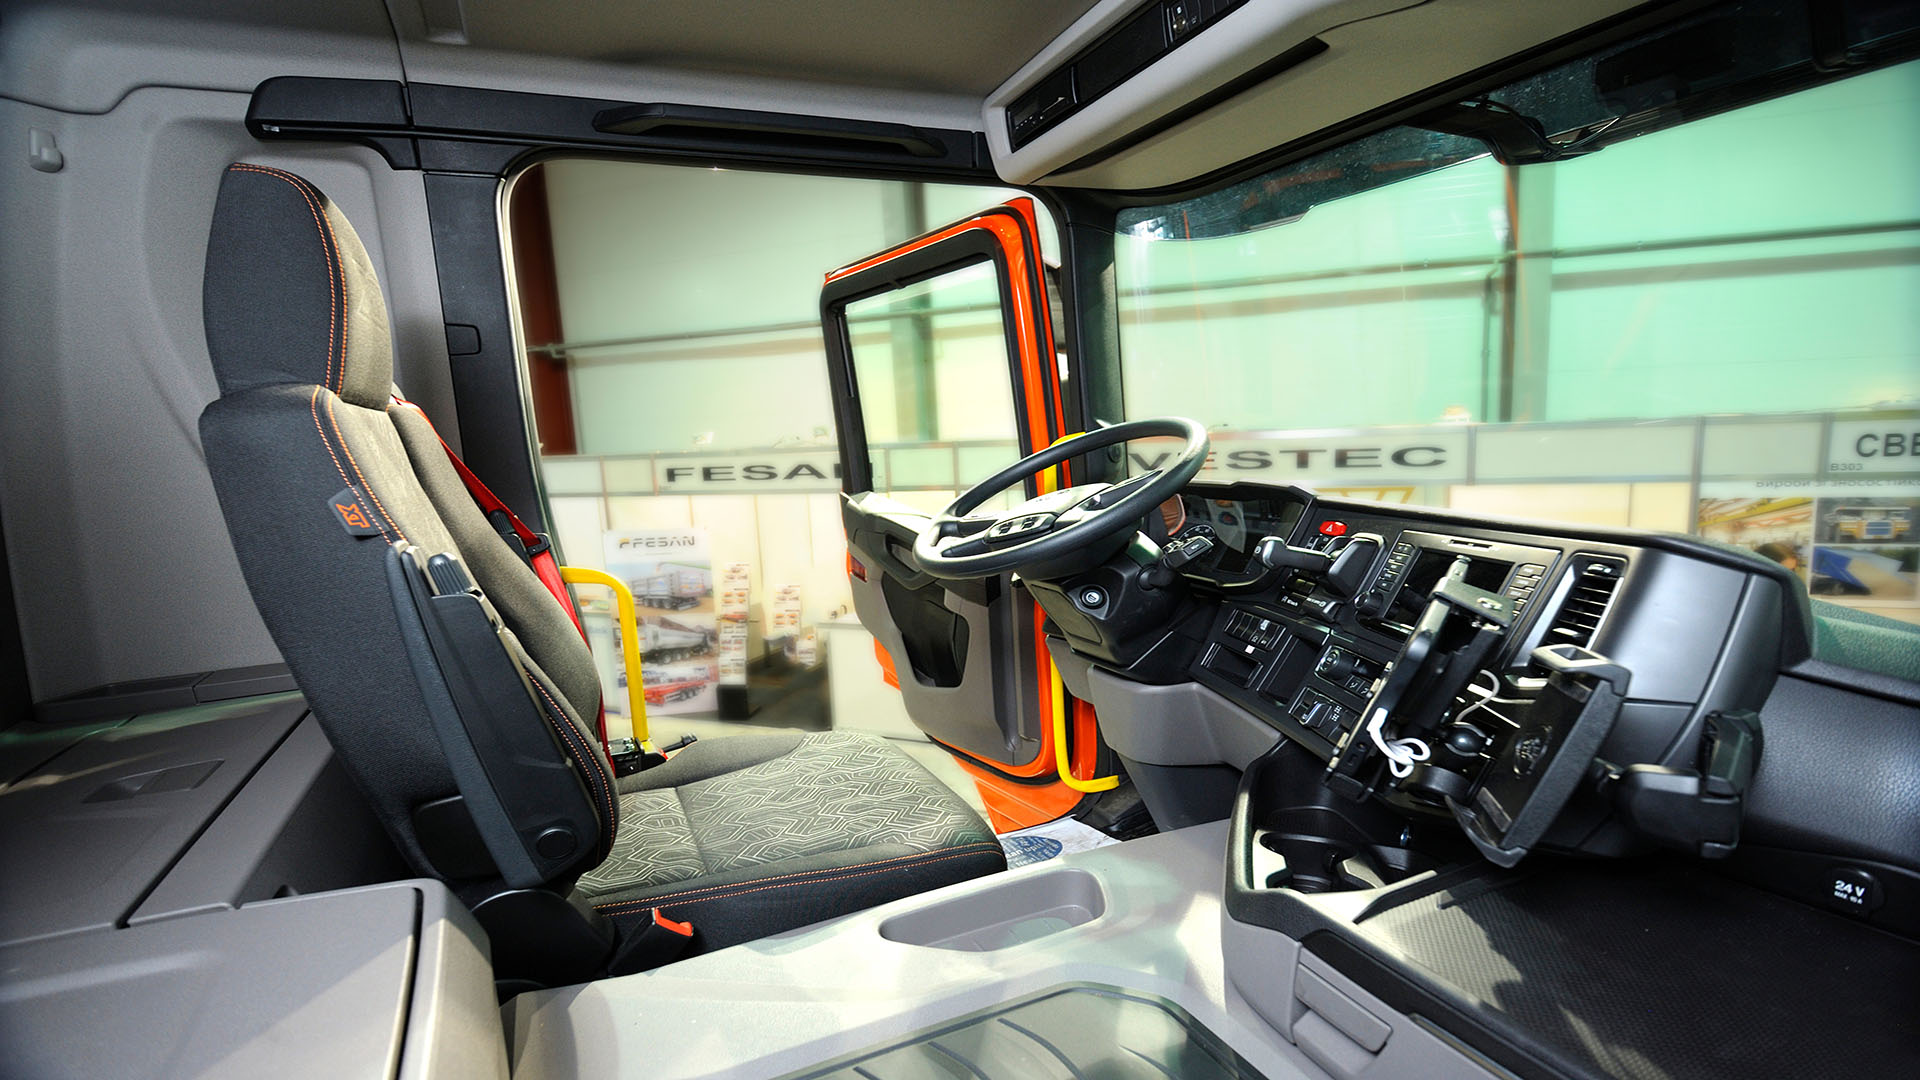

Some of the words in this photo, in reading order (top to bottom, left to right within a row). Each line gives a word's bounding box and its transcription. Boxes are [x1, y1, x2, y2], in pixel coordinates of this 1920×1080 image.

[666, 463, 873, 483] FESA
[633, 536, 695, 549] FESAN
[1834, 880, 1853, 894] 24
[1855, 886, 1865, 897] V
